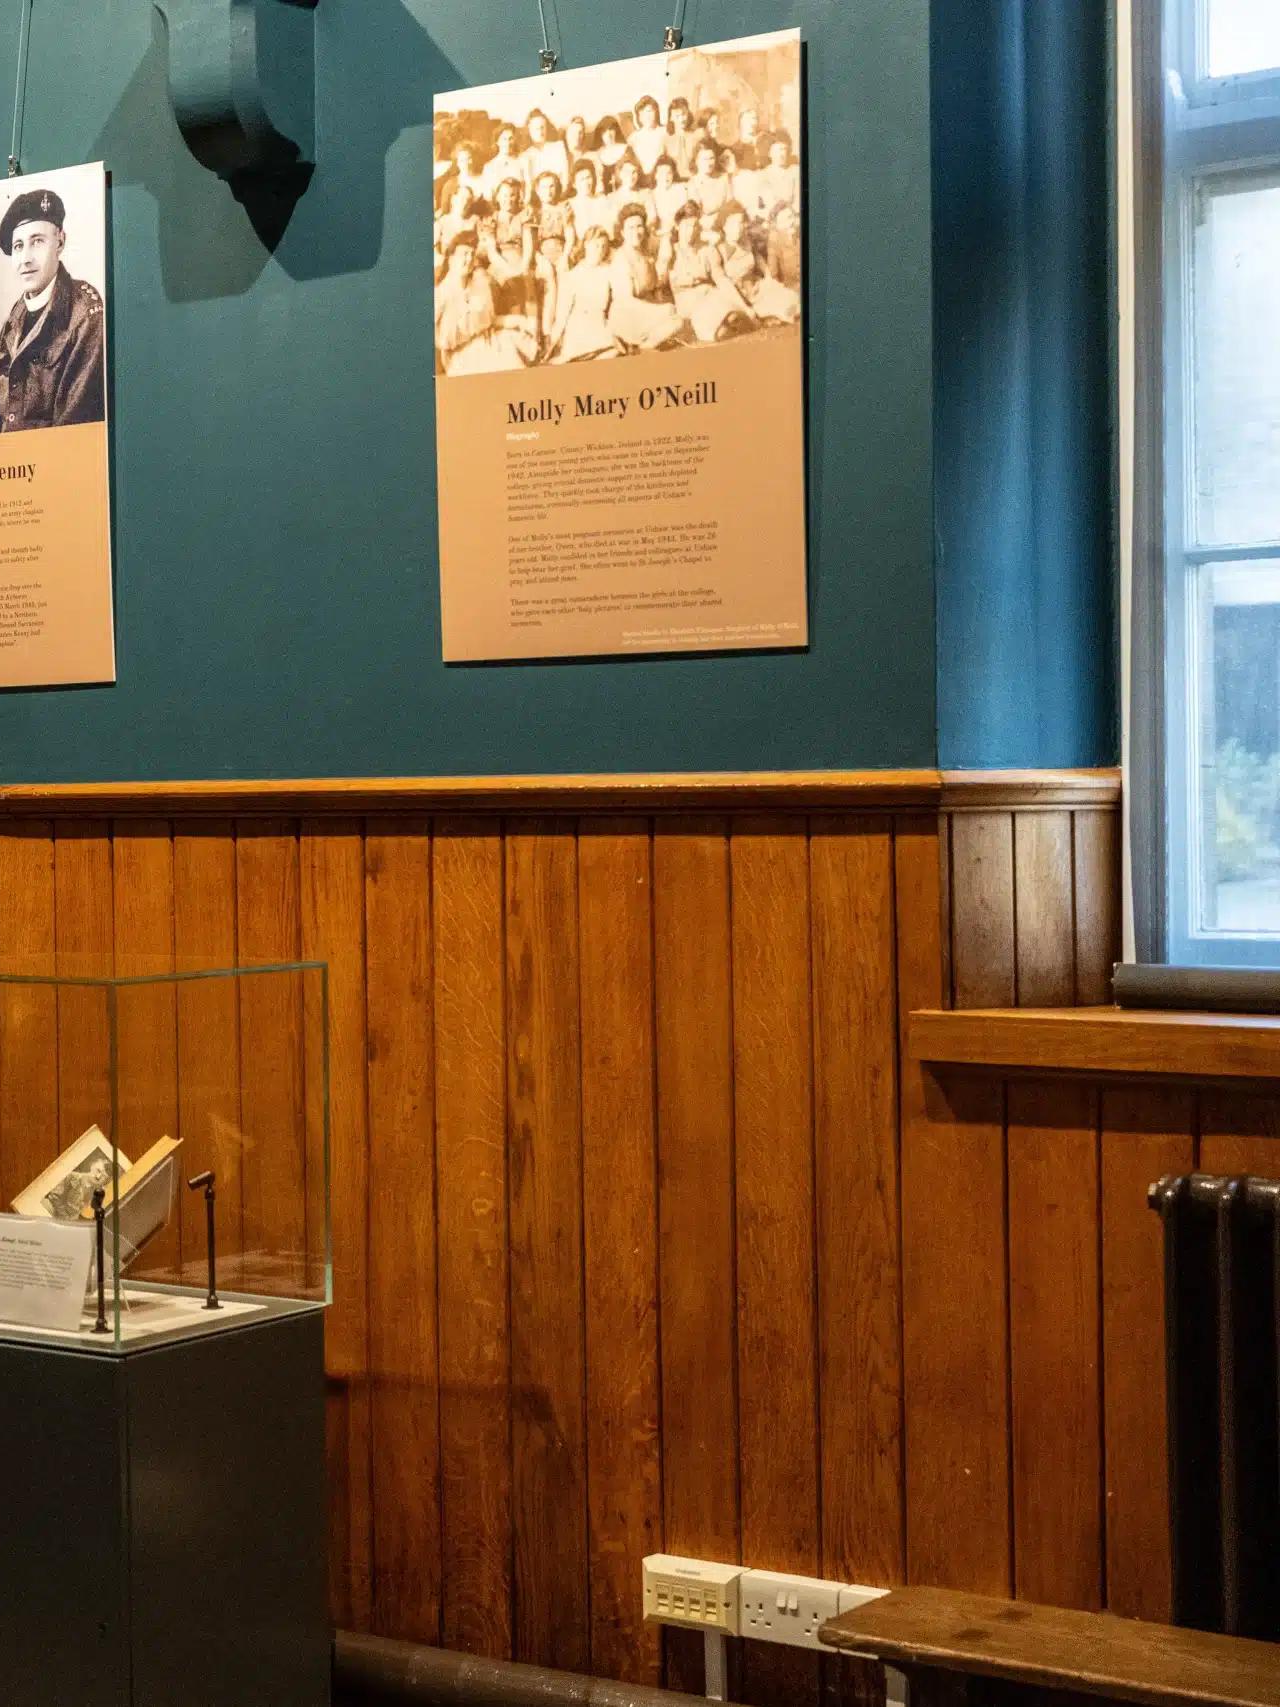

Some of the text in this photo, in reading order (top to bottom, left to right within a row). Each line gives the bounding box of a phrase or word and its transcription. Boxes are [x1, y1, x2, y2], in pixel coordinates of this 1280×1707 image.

[507, 381, 718, 425] Molly Mary O'Neill
